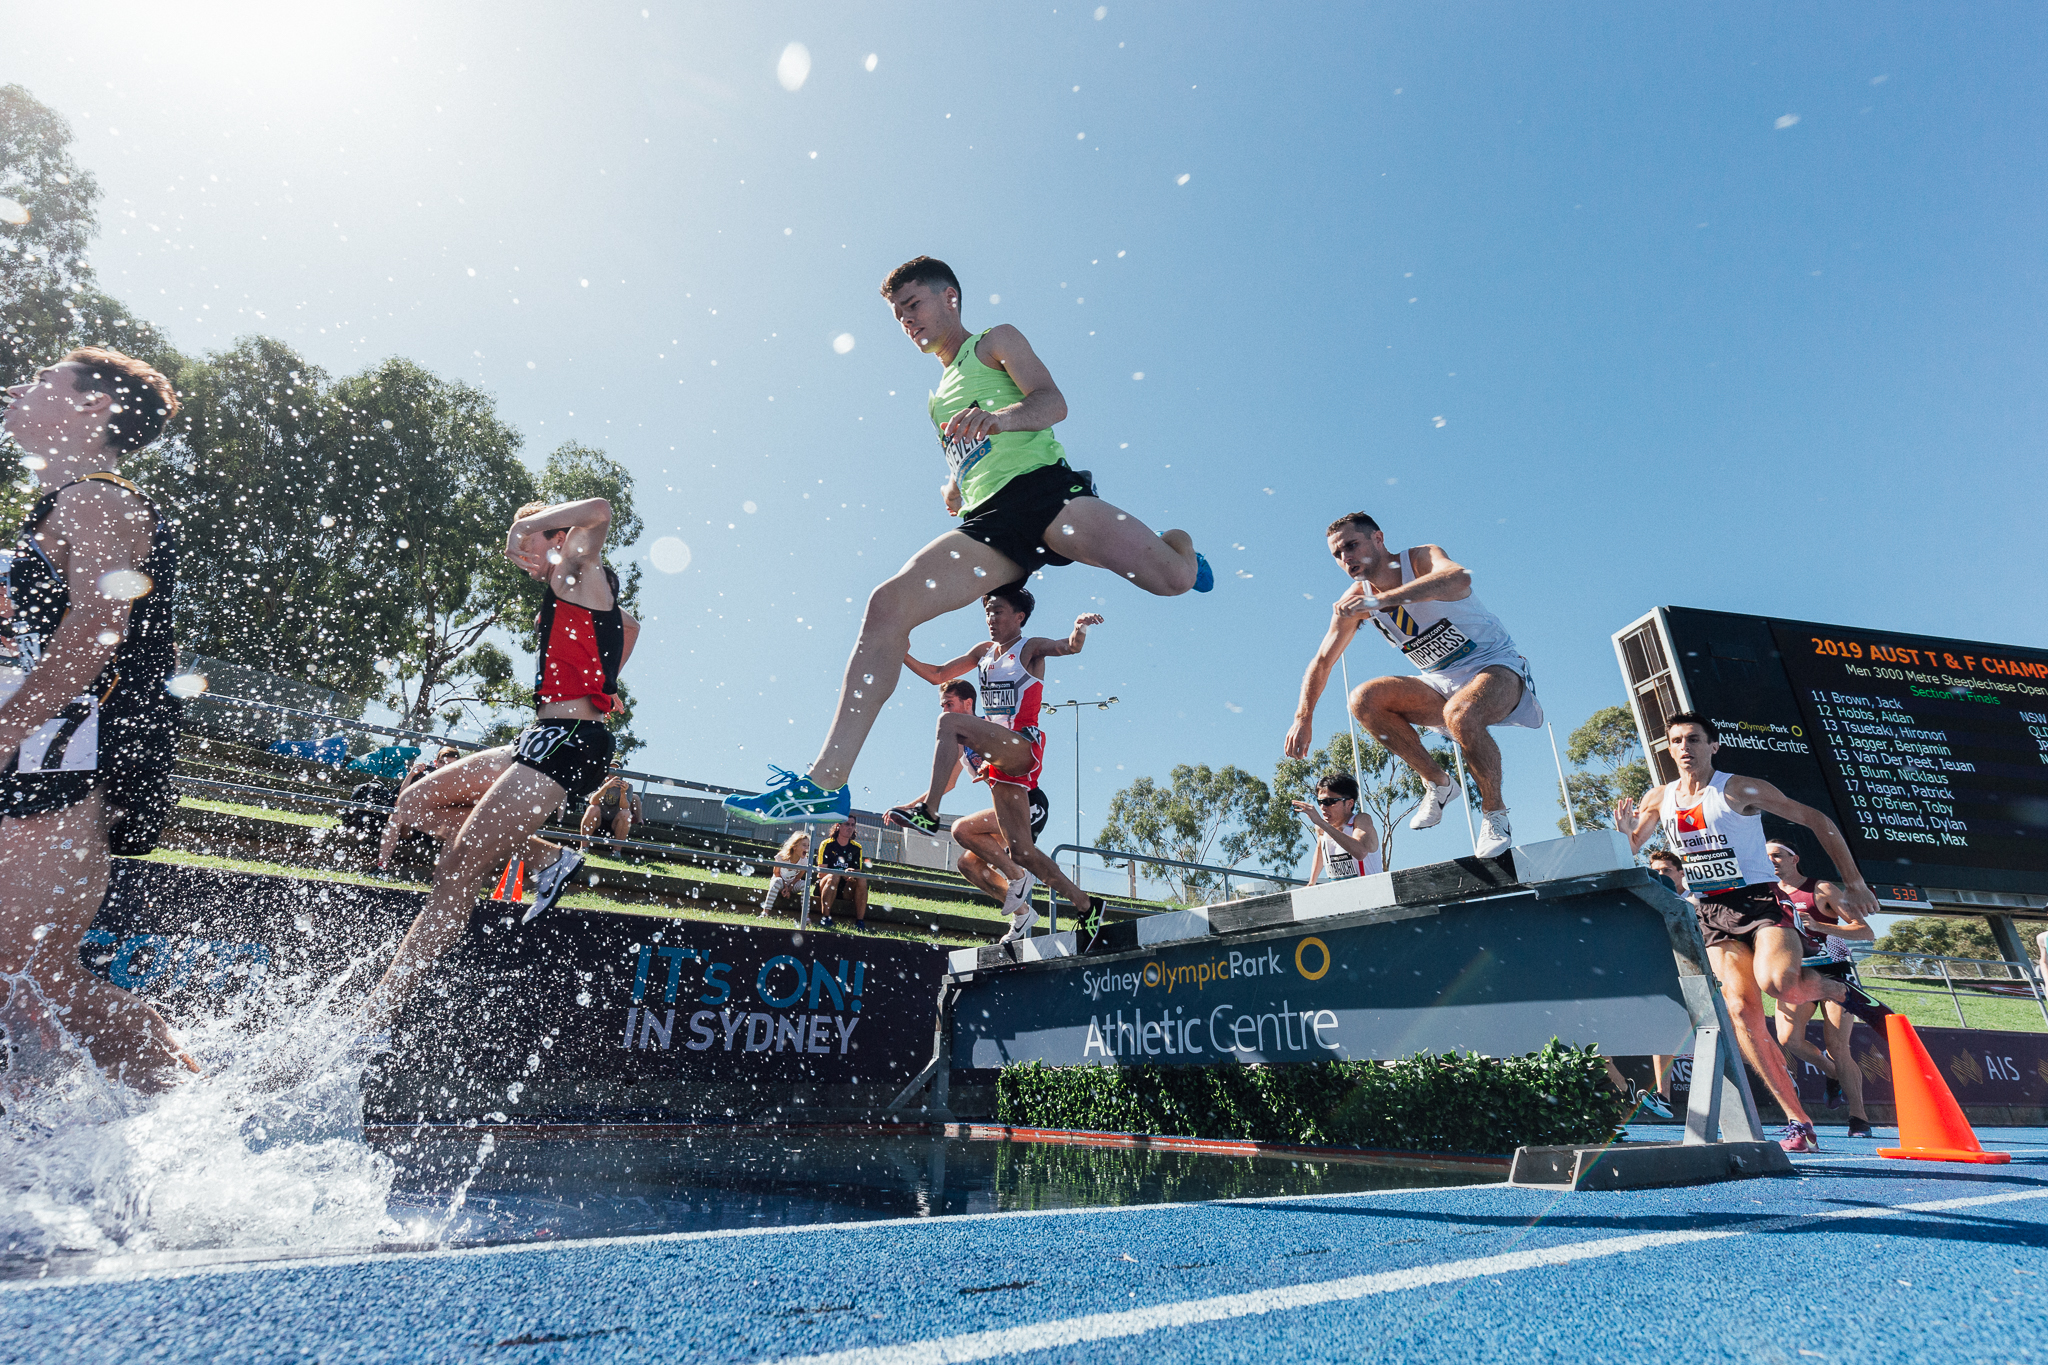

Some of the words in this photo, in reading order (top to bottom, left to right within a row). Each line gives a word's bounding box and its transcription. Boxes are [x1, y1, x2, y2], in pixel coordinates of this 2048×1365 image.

[1811, 638, 1862, 659] 2019
[1870, 645, 1921, 666] AUST
[1924, 651, 1938, 667] T
[1945, 653, 1962, 670] &
[1964, 656, 1976, 671] F
[1845, 664, 1871, 677] Men
[1875, 667, 1904, 680] 3000
[1907, 671, 1940, 684] Metre
[1942, 674, 2016, 692] Steeplechase
[2018, 683, 2048, 696] Open
[981, 690, 1013, 706] TSUETAKI
[1811, 690, 1826, 702] 11
[1831, 692, 1875, 709] Brown,
[1878, 696, 1904, 710] Jack
[1910, 686, 1952, 700] Section
[1956, 689, 1966, 701] 1
[1966, 691, 2001, 705] Finals
[1817, 705, 1832, 717] 12
[1838, 706, 1879, 723] Hobbs,
[1882, 711, 1914, 724] Aidan
[2019, 711, 2047, 724] NSW
[1822, 720, 1838, 731] 13
[1842, 720, 1898, 738] Tsuetaki,
[1899, 727, 1947, 741] Hironori
[522, 728, 561, 758] 18
[1719, 733, 1768, 750] Athletic
[1768, 737, 1809, 754] Centre
[1828, 735, 1843, 746] 14
[1849, 735, 1893, 752] Jagger,
[1894, 741, 1951, 757] Benjamin
[1833, 749, 1849, 761] 15
[1853, 750, 1879, 764] Van
[1882, 753, 1903, 766] Der
[1907, 756, 1938, 770] Peet,
[1940, 759, 1975, 772] Ieuan
[1839, 764, 1855, 776] 16
[1859, 766, 1896, 781] Blum,
[1898, 769, 1949, 784] Nicklaus
[1844, 780, 1859, 791] 17
[1865, 781, 1910, 797] Hagan,
[1911, 786, 1955, 800] Patrick
[1850, 795, 1867, 807] 18
[1872, 796, 1922, 813] O'Brien,
[1922, 801, 1953, 816] Toby
[1856, 811, 1872, 823] 19
[1877, 812, 1929, 830] Holland,
[1932, 816, 1967, 832] Dylan
[1683, 833, 1728, 848] raining
[1862, 827, 1878, 839] 20
[1884, 828, 1940, 846] Stevens,
[1941, 833, 1968, 846] Max
[1690, 851, 1729, 862] sydney.com
[1685, 861, 1738, 881] HOBBS
[757, 955, 866, 1012] ON!
[1083, 946, 1283, 1001] SydneyOlympicPark
[623, 1007, 675, 1049] IN
[685, 1010, 860, 1055] SYDNEY
[1083, 1006, 1203, 1057] Athletic
[1209, 1000, 1340, 1053] Centre
[1986, 1056, 2020, 1081] AIS
